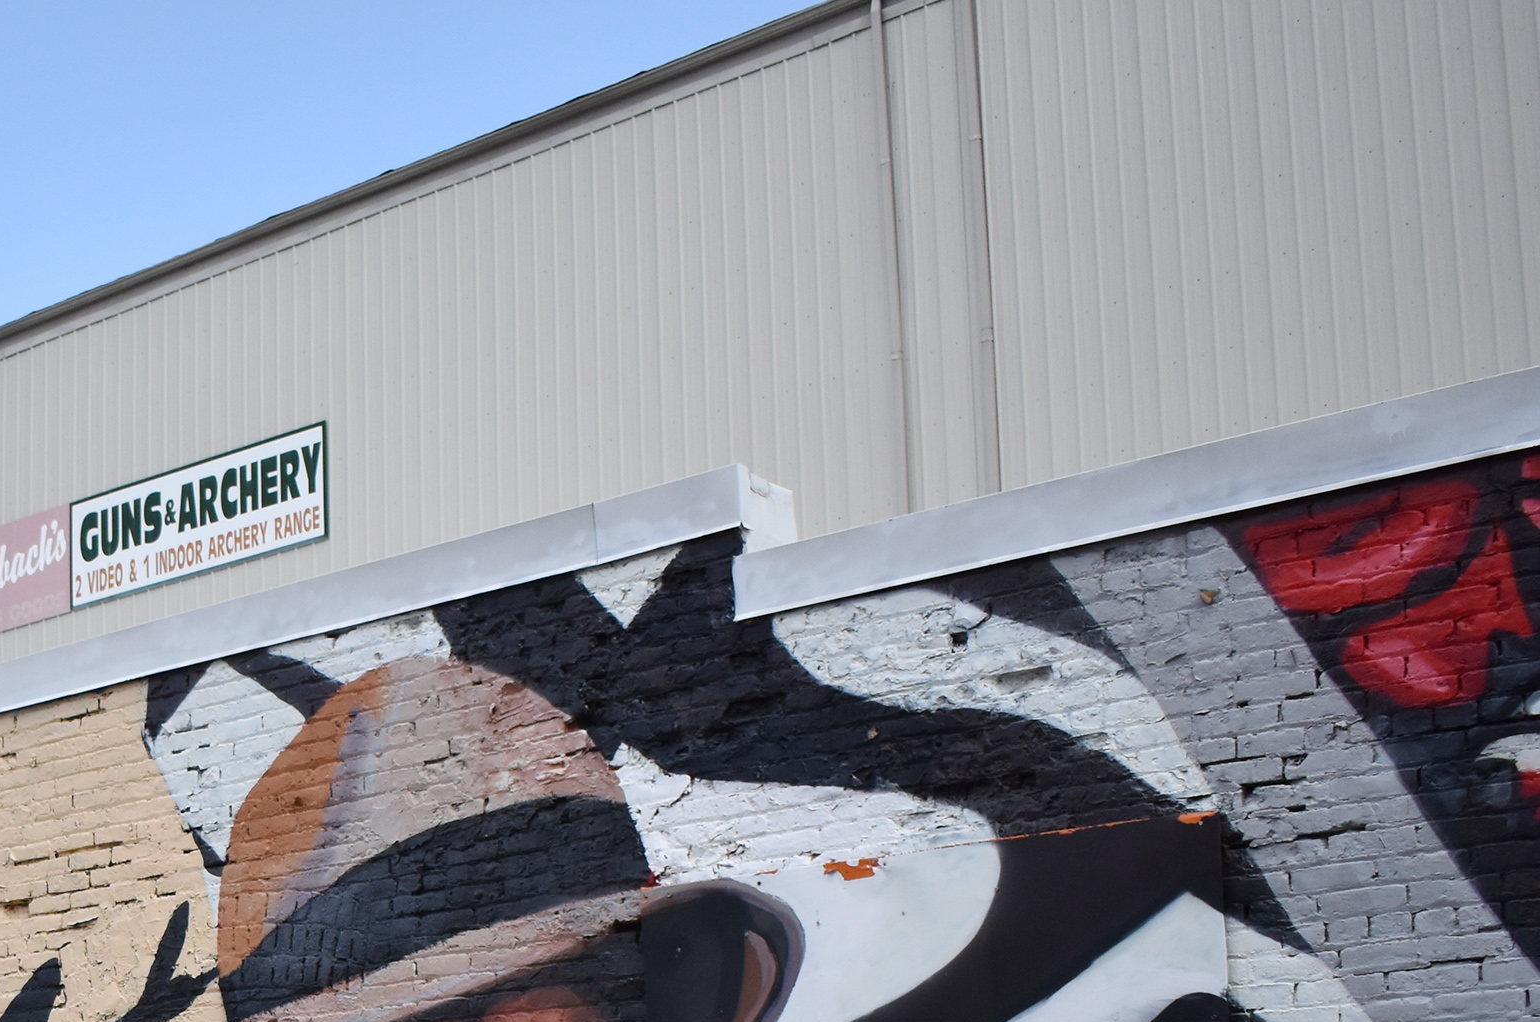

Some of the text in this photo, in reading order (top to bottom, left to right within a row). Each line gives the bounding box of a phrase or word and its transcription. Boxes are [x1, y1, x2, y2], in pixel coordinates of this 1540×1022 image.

[75, 505, 320, 598] 2 VIDEO & 1 INDOOR ARCHERY RANGE
[80, 491, 162, 562] GUNS
[178, 441, 321, 533] ARCHERY
